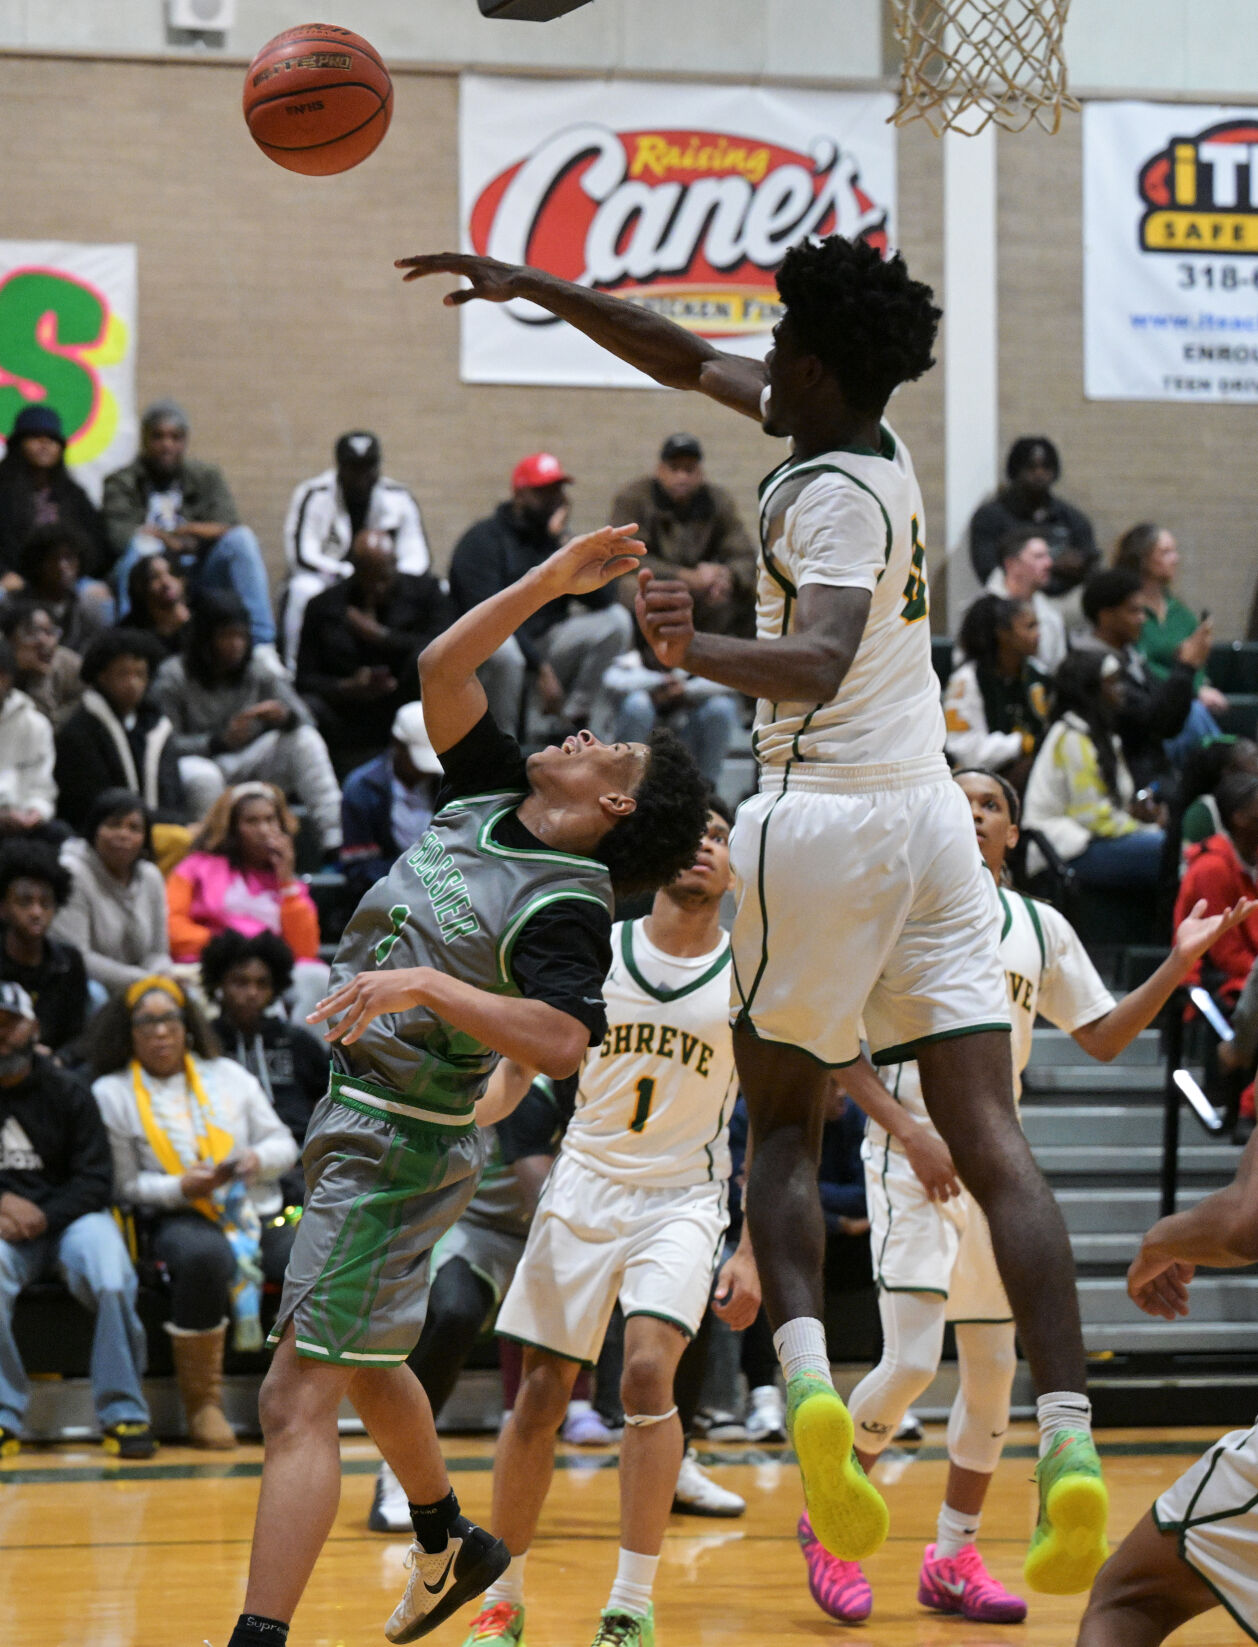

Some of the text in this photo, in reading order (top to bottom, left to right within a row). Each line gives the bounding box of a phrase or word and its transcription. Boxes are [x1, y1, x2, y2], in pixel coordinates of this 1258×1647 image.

[631, 135, 770, 181] Raising
[1174, 142, 1258, 208] iT
[486, 122, 890, 327] Cane's
[1164, 222, 1244, 242] SAFE
[407, 831, 480, 945] BOSSIER
[600, 1022, 714, 1078] SHREVE
[627, 1074, 657, 1134] 1
